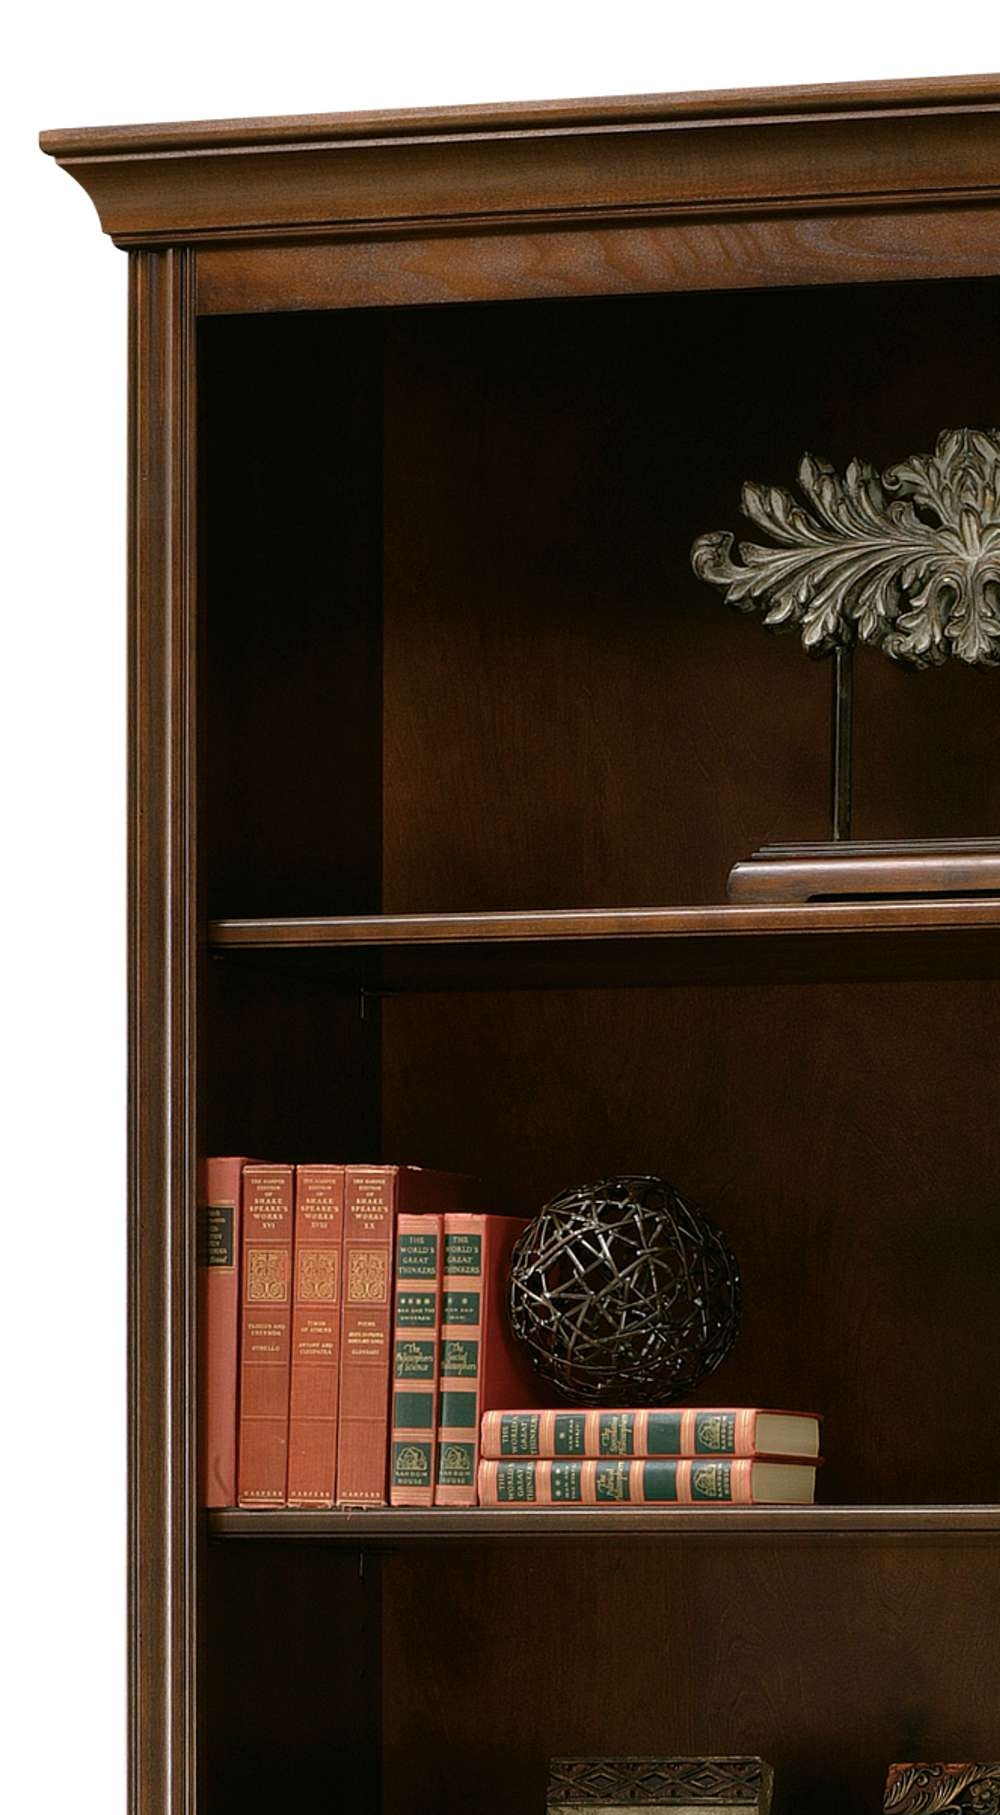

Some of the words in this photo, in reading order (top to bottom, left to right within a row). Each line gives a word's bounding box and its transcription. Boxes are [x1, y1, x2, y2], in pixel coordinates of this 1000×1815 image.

[452, 1236, 469, 1244] THE
[402, 1256, 429, 1264] GREAT
[446, 1256, 472, 1264] GREAT
[403, 1342, 421, 1353] The
[448, 1342, 464, 1352] The
